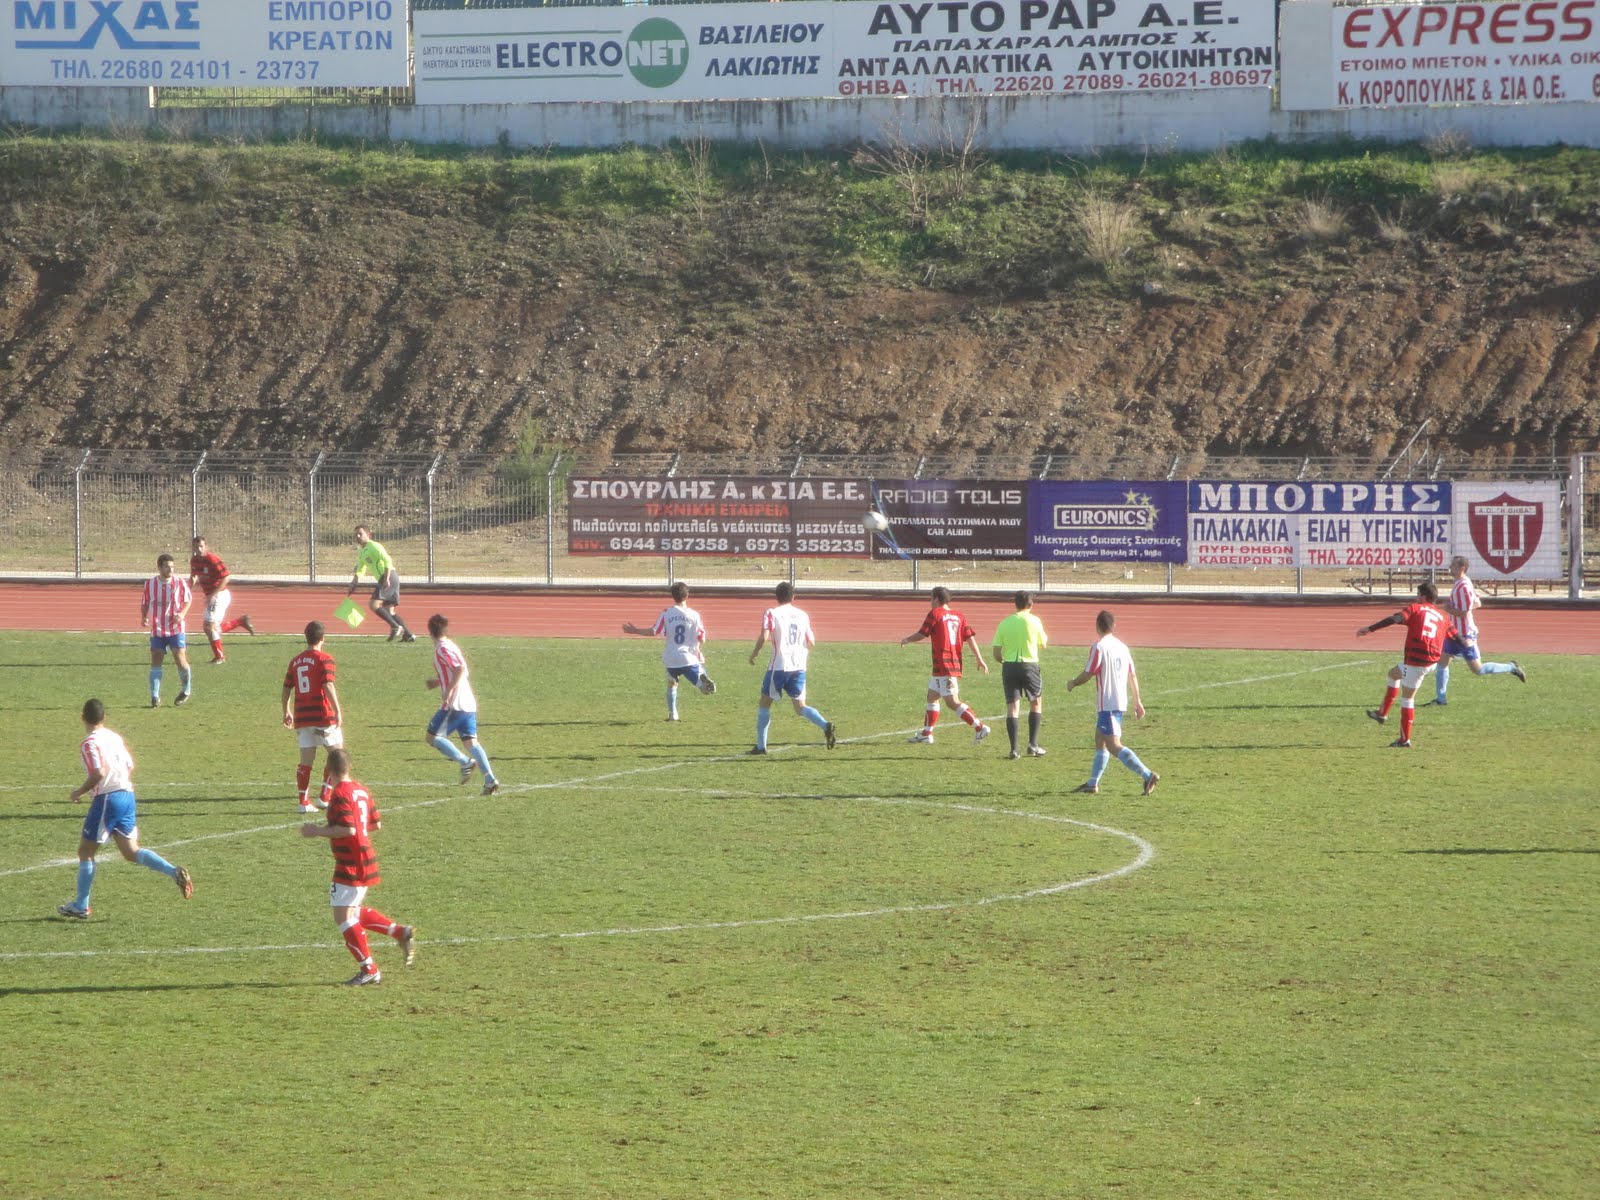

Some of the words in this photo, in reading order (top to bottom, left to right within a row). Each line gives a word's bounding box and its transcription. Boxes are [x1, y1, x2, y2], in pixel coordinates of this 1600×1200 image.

[268, 0, 392, 21] ΕΜΠΟΡΙΟ
[1138, 1, 1239, 27] Α.Ε.
[14, 1, 200, 49] ΜΙΧΑΣ
[699, 23, 824, 45] ΒΑΣΙΛΕΙΟΥ
[1343, 1, 1596, 48] EXPRESS
[268, 30, 392, 50] ΚΡΕΑΤΩΝ
[893, 32, 1178, 52] ΠΑΠΑΧΑΡΑΛΑΜΠΟΣ
[1191, 31, 1216, 44] Χ.
[496, 41, 623, 69] ELECTRO
[628, 40, 685, 66] NET
[838, 53, 1053, 77] ΑΝΤΑΛΛΑΚΤΙΚΑ
[1077, 47, 1272, 71] ΑΥΤΟΚΙΝΗΤΩΝ
[1340, 58, 1406, 72] ΕΤΟΙΜΟ
[1412, 56, 1487, 70] ΜΠΕΤΟΝ
[1509, 52, 1562, 66] ΥΛΙΚΑ
[51, 60, 96, 79] ΤΗΛ.
[101, 60, 163, 79] 22680
[170, 60, 230, 79] 24101
[256, 60, 319, 80] 23737
[705, 55, 820, 76] ΛΑΚΙΩΤΗΣ
[936, 78, 984, 94] ΤΗΛ.
[994, 76, 1054, 92] 22620
[1063, 74, 1124, 90] 27089
[1138, 72, 1197, 88] 26021
[1210, 69, 1272, 86] 80697
[1338, 82, 1354, 105] Κ.
[1360, 78, 1476, 104] ΚΟΡΟΠΟΥΛΗΣ
[1482, 79, 1492, 100] &
[1500, 76, 1528, 100] ΣΙΑ
[1533, 75, 1566, 99] Ο.Ε.
[572, 480, 716, 499] ΣΠΟΥΡΛΗΣ
[721, 481, 746, 499] Α.
[771, 481, 815, 499] ΣΙΑ
[822, 482, 865, 500] Ε.Ε.
[878, 489, 948, 504] RADIO
[954, 490, 1023, 505] TOLIS
[1199, 483, 1440, 512] ΜΠΟΓΡΗΣ
[645, 503, 716, 516] ΤΕΧΝΙΚΗ
[719, 503, 790, 517] ΕΤΑΙΡΕΙΑ
[1061, 509, 1147, 526] EURONICS
[927, 528, 944, 536] CAR
[946, 528, 973, 536] AUDIO
[947, 517, 997, 526] ΣΥΣΤΗΜΑΤΑ
[999, 518, 1022, 526] ΗΧΟΥ
[1193, 518, 1290, 541] ΠΛΑΚΑΚΙΑ
[1308, 518, 1350, 542] ΕΙΔΗ
[1361, 519, 1448, 543] ΥΓΙΕΙΝΗΣ
[609, 537, 656, 550] 6944
[661, 538, 729, 551] 587358
[745, 539, 790, 551] 6973
[796, 539, 866, 552] 358235
[1034, 535, 1088, 546] Ηλεκτρικές
[1090, 535, 1132, 546] Οικιακές
[1135, 535, 1182, 547] Συσκευές
[1199, 545, 1234, 553] ΠΥΡΙ
[1240, 545, 1293, 554] ΘΗΒΩΝ
[1199, 555, 1272, 564] ΚΑΒΕΙΡΩΝ
[1278, 556, 1293, 564] 36
[1307, 548, 1341, 566] ΤΗΛ.
[1345, 547, 1392, 566] 22620
[1397, 548, 1444, 566] 23309
[674, 624, 686, 645] 8
[1421, 611, 1438, 639] 5
[297, 665, 310, 694] 6
